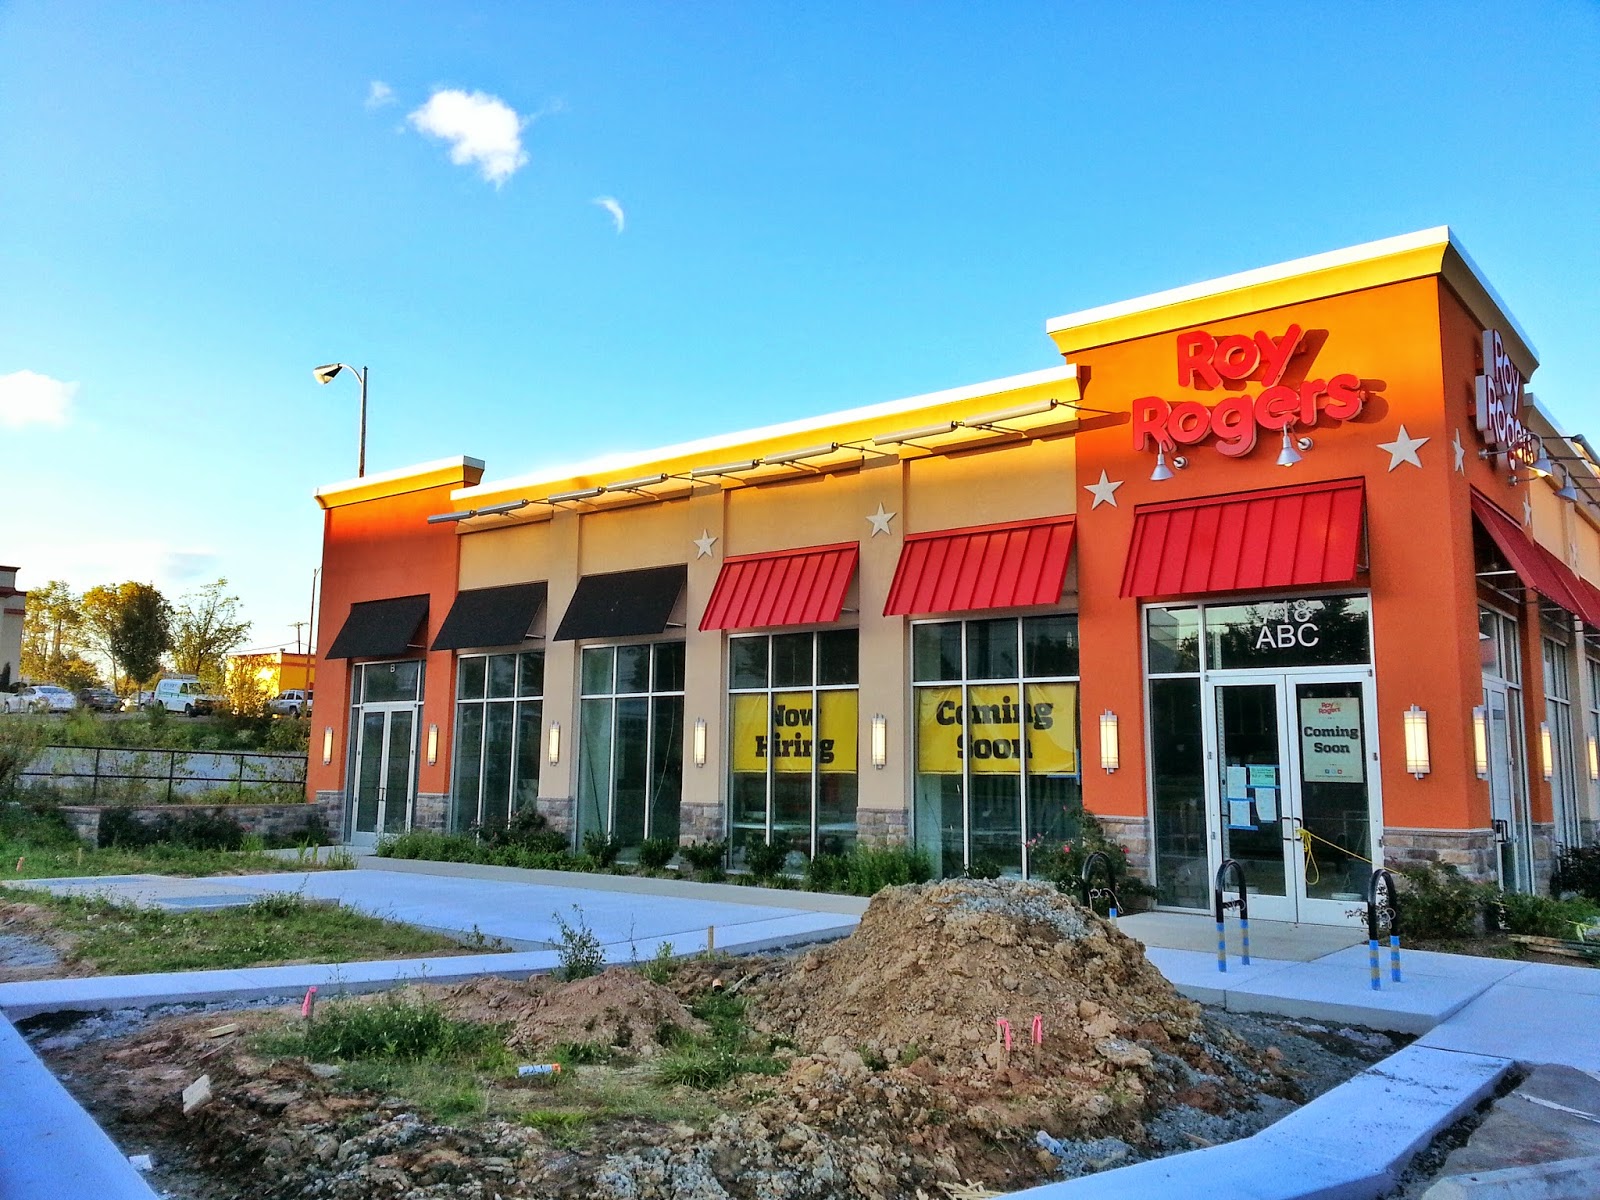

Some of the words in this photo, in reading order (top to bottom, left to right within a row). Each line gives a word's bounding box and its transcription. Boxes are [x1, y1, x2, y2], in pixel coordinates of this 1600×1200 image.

[1177, 324, 1302, 388] Roy
[1491, 329, 1520, 416] Roy
[1132, 373, 1362, 458] Rogers
[1255, 622, 1319, 649] ABC
[390, 663, 396, 673] B
[936, 695, 1054, 730] Coming
[957, 734, 1033, 759] Soon
[1303, 725, 1359, 740] Coming
[755, 732, 835, 764] Hiring
[1314, 742, 1350, 753] Soon
